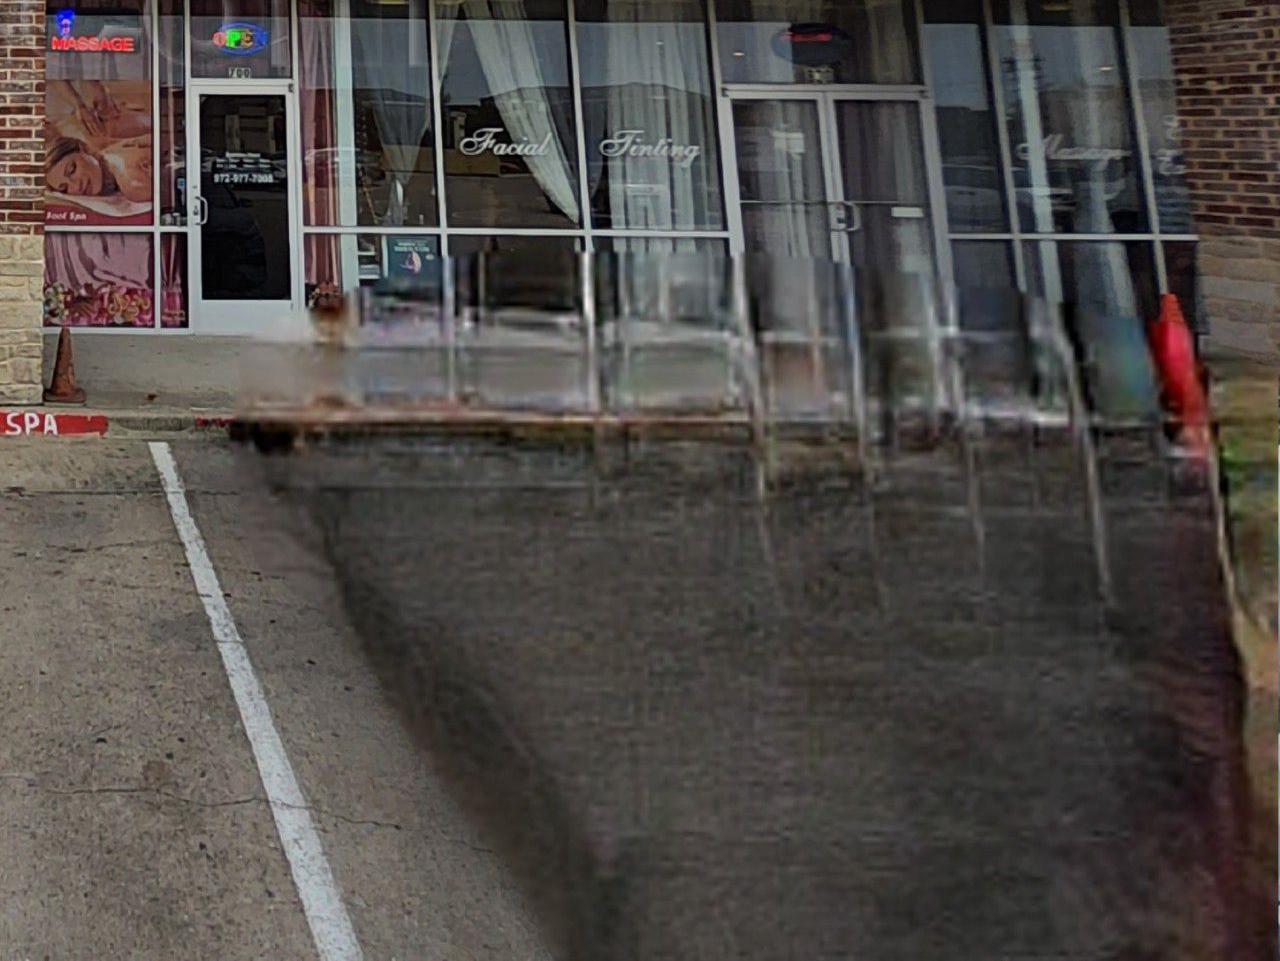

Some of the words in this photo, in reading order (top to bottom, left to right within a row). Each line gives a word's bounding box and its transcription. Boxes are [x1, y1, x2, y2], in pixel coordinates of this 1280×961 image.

[51, 35, 135, 52] MASSAGE
[212, 27, 268, 49] OPEN
[460, 127, 552, 156] Facial
[598, 130, 701, 168] Tinting
[5, 412, 59, 436] SPA
